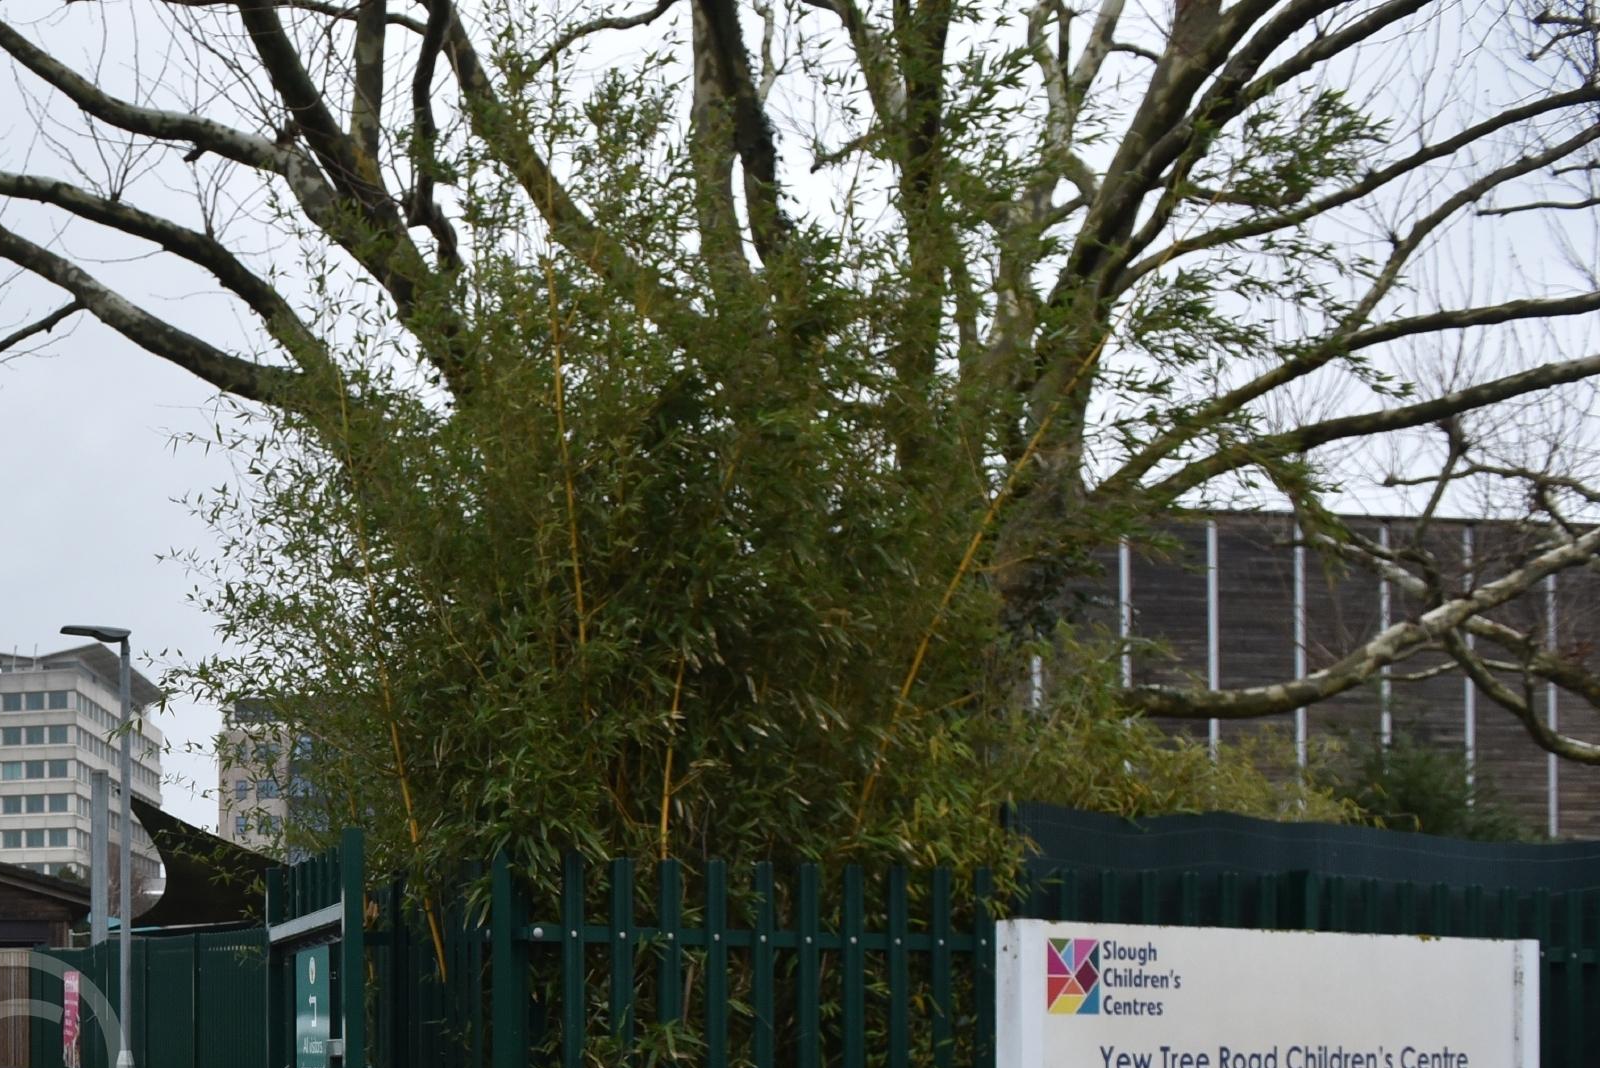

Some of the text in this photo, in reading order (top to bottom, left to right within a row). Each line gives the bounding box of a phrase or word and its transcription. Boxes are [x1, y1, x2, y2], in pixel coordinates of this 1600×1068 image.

[1103, 940, 1158, 967] Slough
[1103, 968, 1182, 989] Children's
[1103, 995, 1164, 1016] Centres
